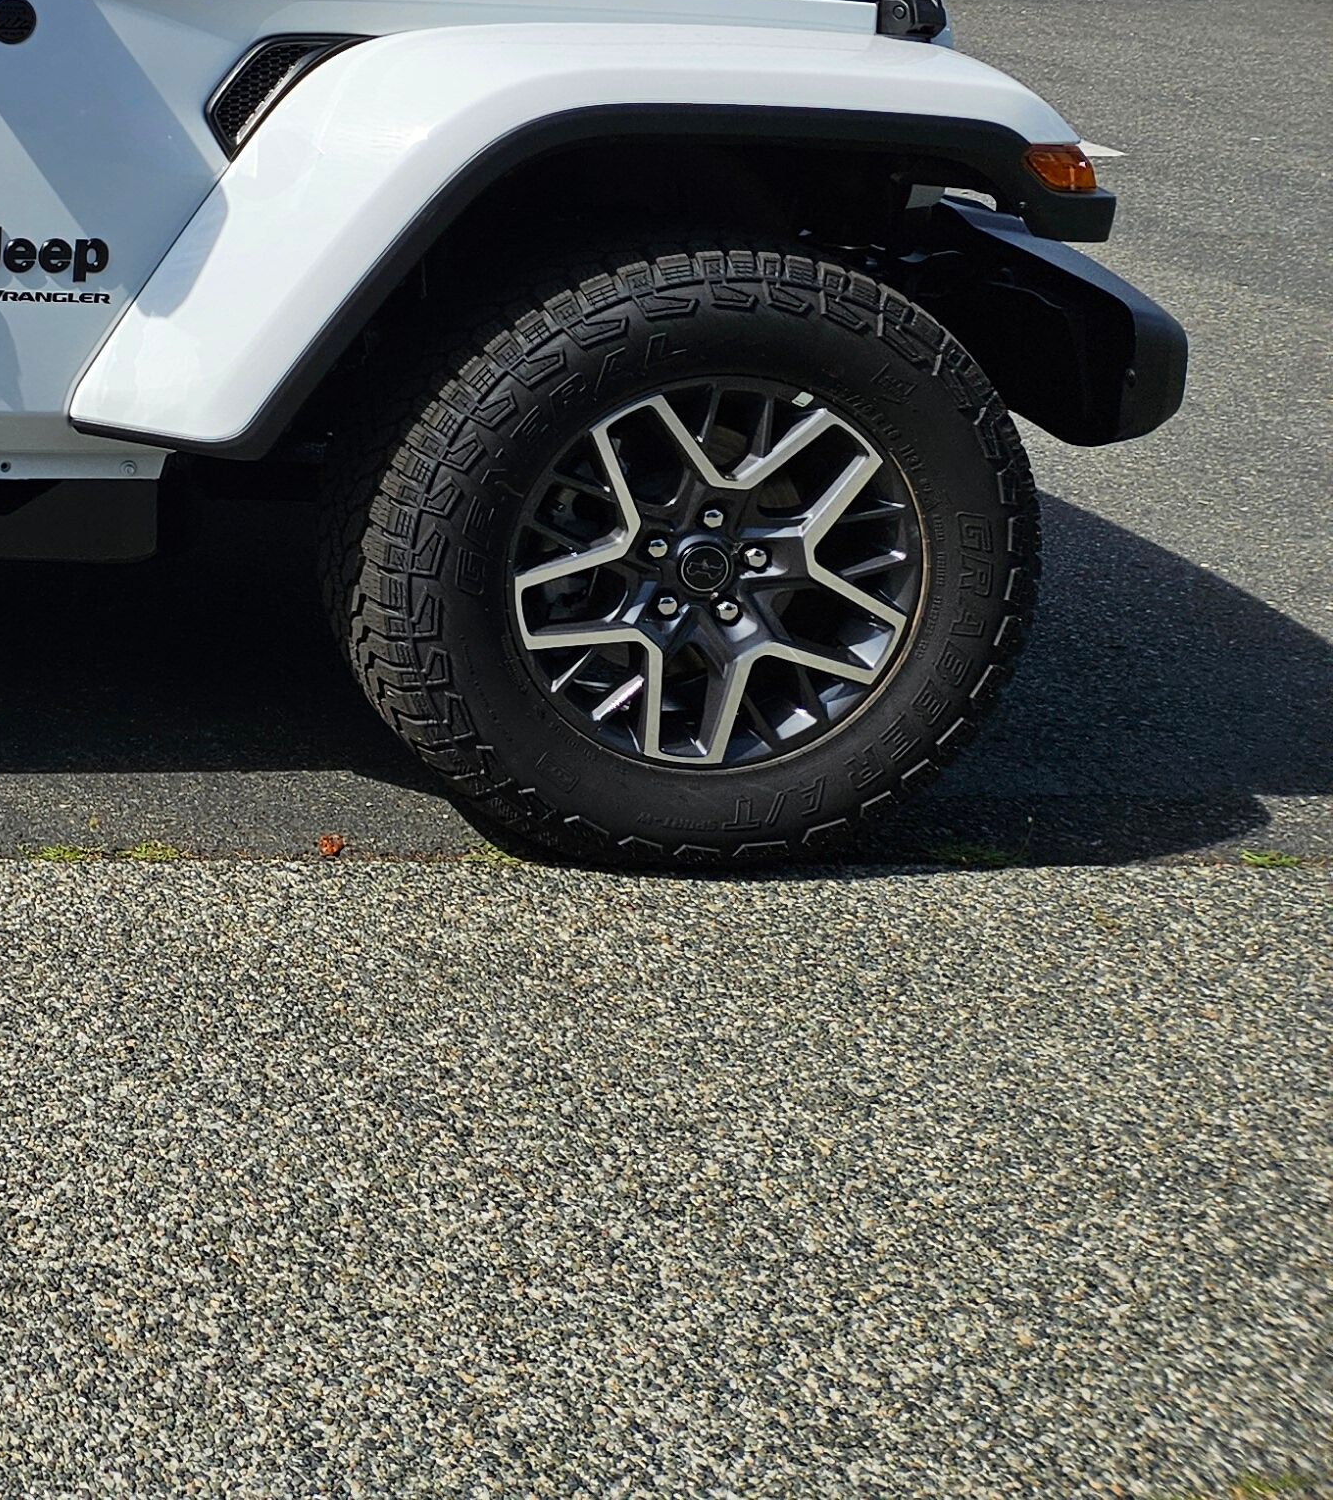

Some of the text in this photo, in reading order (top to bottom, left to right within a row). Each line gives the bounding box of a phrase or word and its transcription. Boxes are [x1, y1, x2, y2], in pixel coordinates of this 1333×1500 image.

[454, 331, 688, 594] GENERAL
[840, 511, 993, 791] GRABBER
[720, 773, 837, 831] A/T
